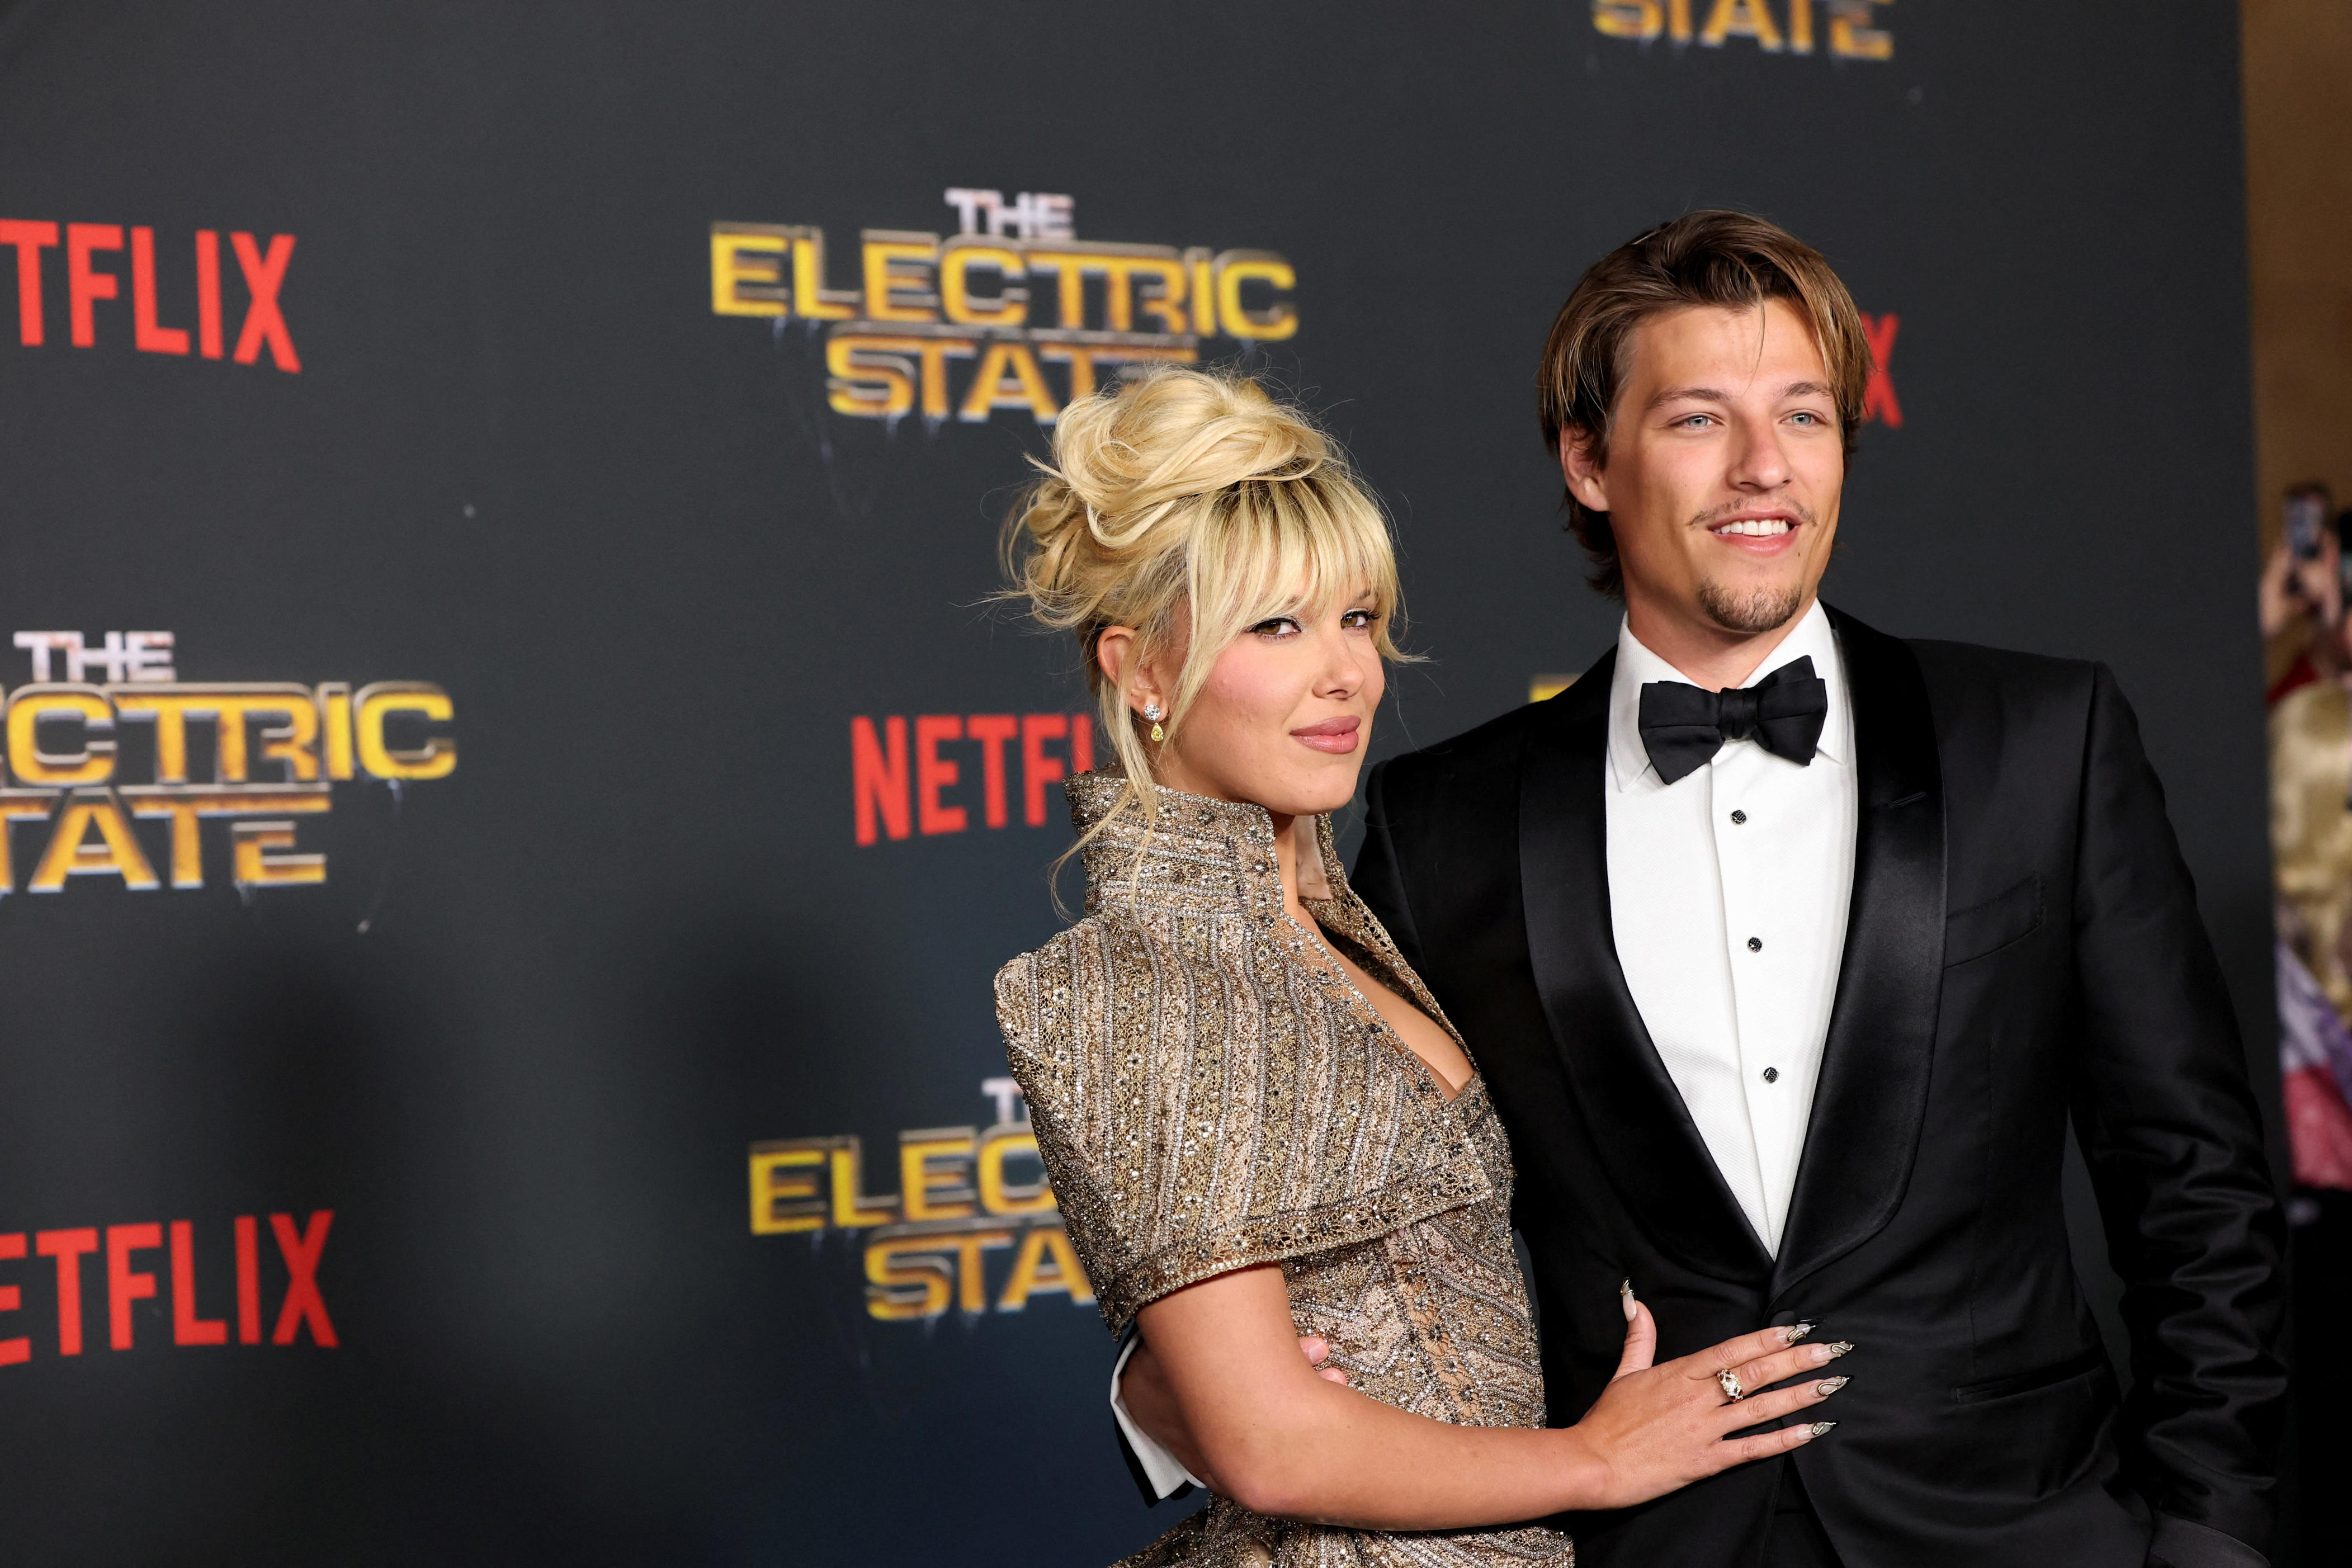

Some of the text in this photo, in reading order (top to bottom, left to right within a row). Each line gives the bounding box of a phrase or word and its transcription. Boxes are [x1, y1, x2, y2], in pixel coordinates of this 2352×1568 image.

[943, 187, 1075, 240] THE
[0, 219, 303, 374] TFLIX
[711, 220, 1298, 341] ELECTRIC
[825, 319, 1198, 424] STAT
[13, 631, 176, 683] THE
[0, 681, 457, 786] CTRIC
[851, 712, 1094, 848] NETF
[748, 1125, 1061, 1236] ELEC
[0, 1209, 339, 1366] TFLIX
[864, 1215, 1099, 1321] STA
